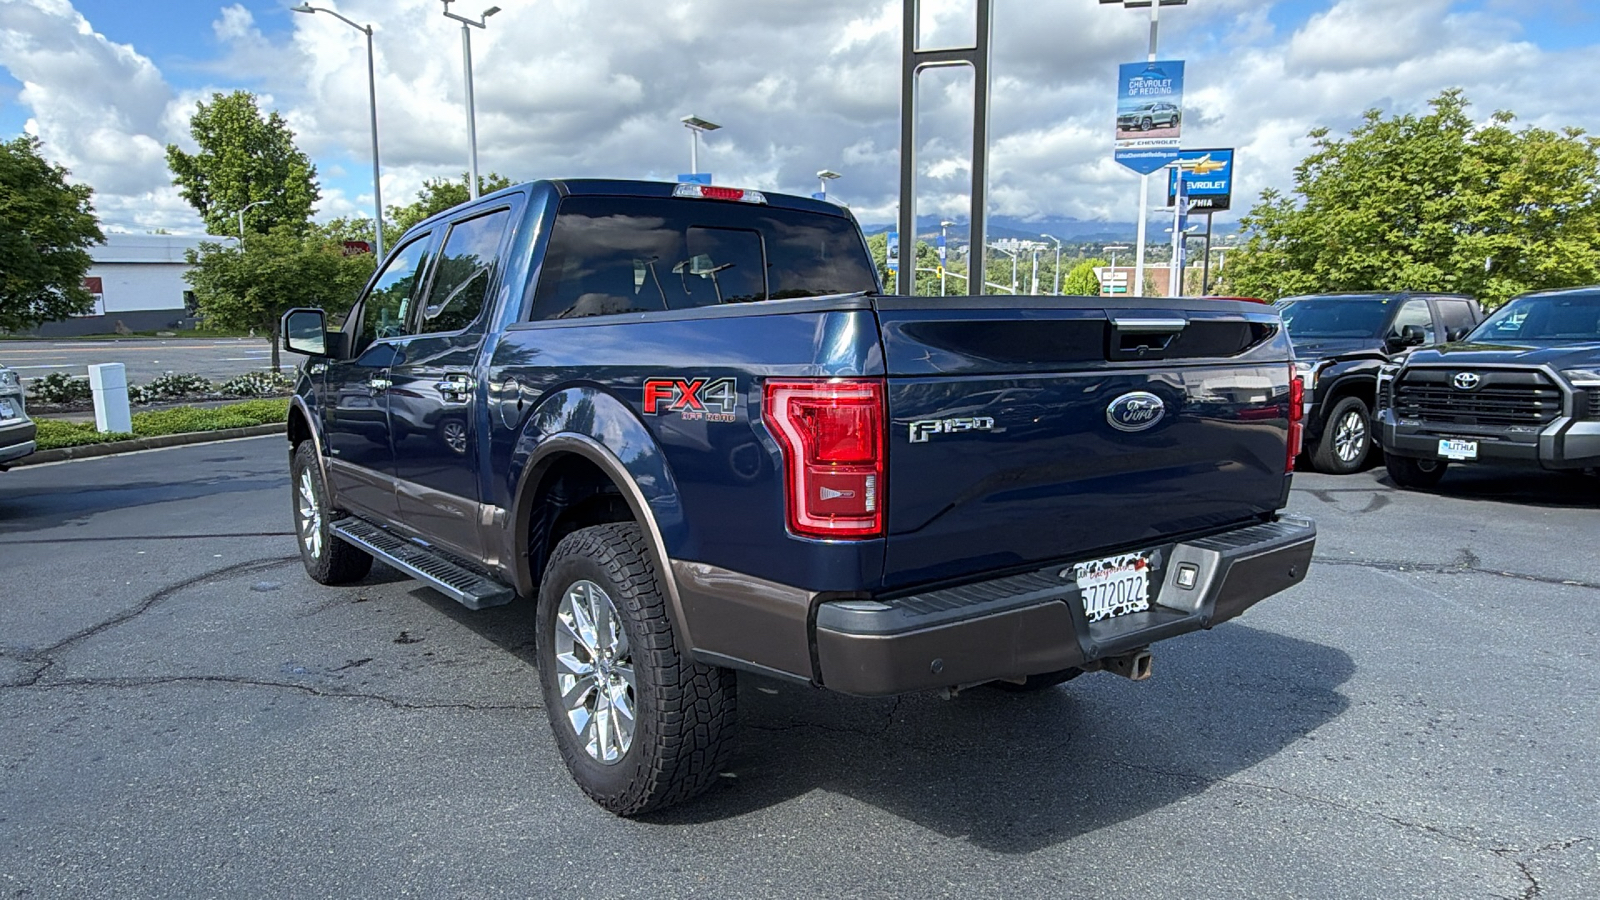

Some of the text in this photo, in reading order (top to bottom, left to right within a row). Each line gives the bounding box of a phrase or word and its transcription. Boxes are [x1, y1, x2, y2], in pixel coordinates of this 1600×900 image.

[1129, 79, 1172, 88] CHEVROLET
[1140, 87, 1172, 95] REDDING
[1174, 181, 1226, 189] EVROLET
[642, 377, 738, 416] FX4
[1122, 399, 1154, 422] Ford
[681, 412, 703, 420] OFF
[1449, 443, 1474, 451] LITHIA
